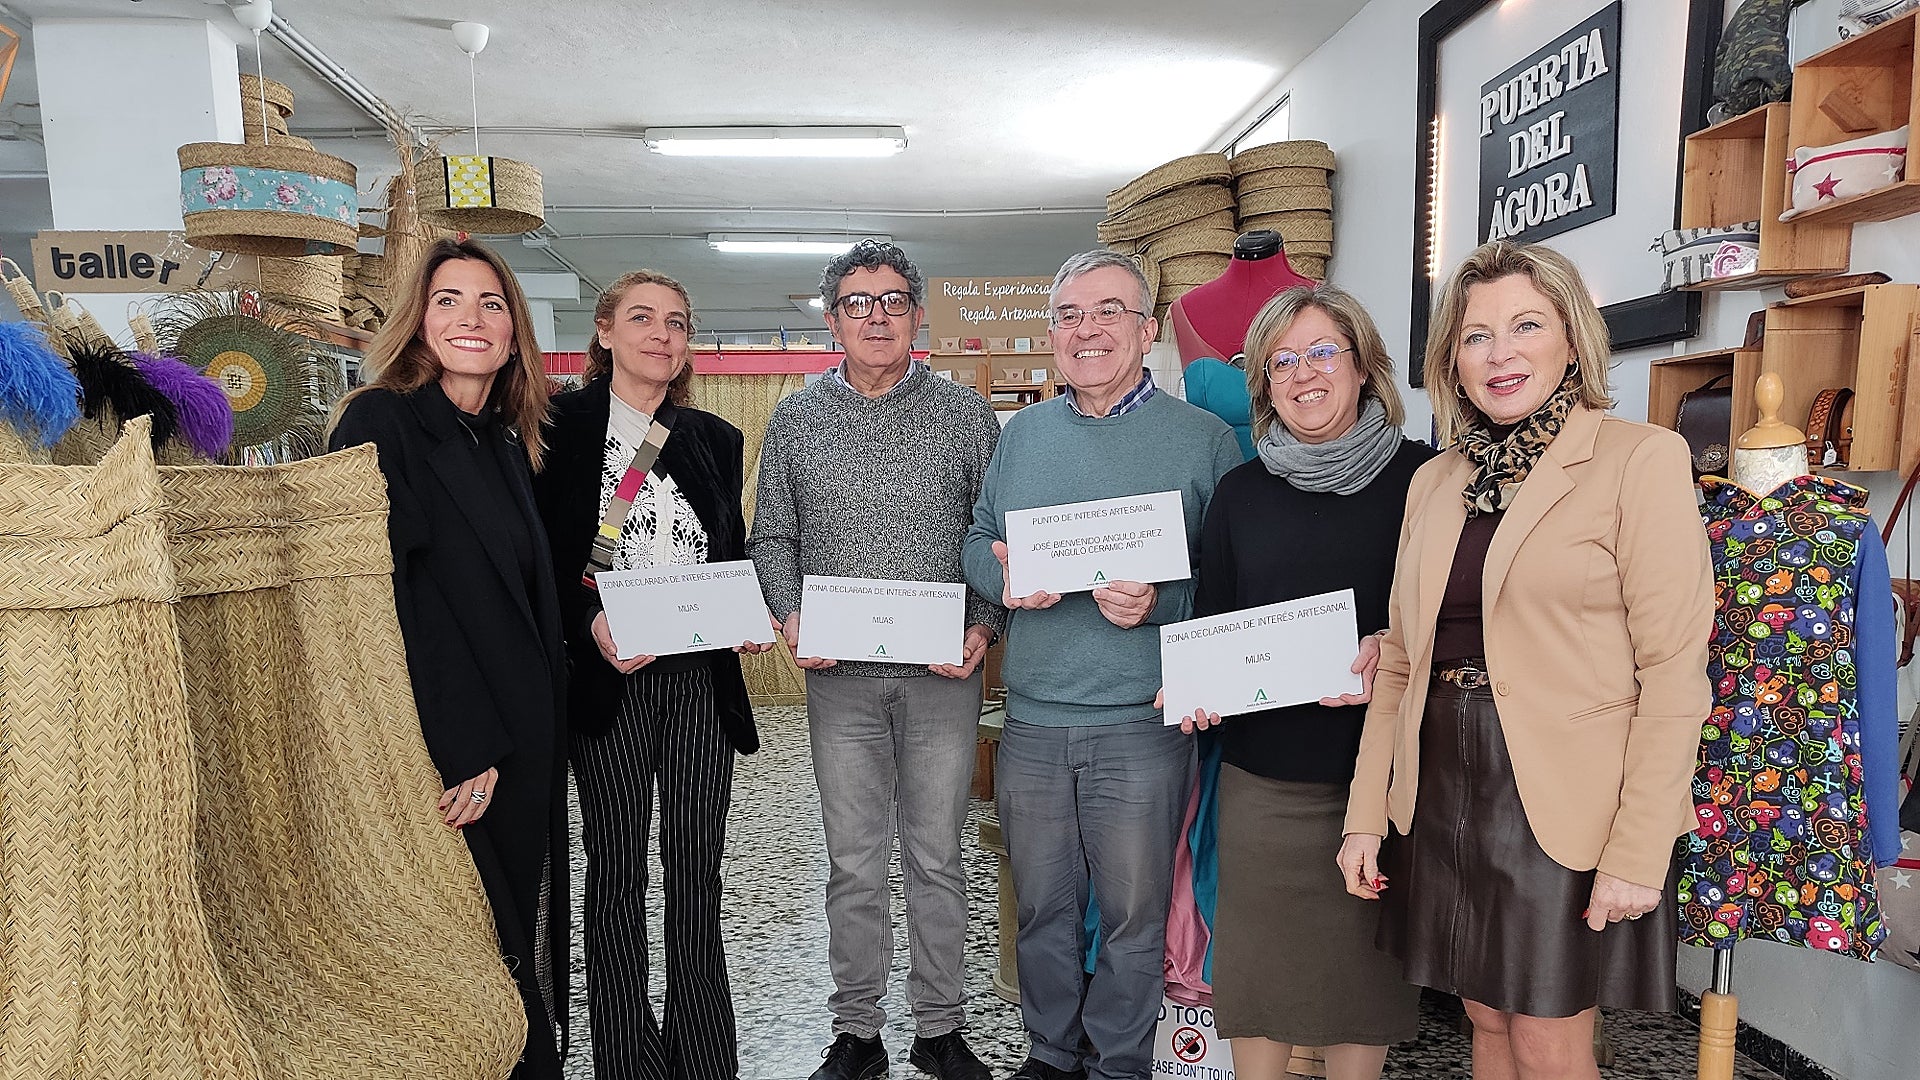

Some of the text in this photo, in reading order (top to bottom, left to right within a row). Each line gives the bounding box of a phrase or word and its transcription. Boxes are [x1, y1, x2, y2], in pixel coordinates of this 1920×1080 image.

[1480, 28, 1609, 138] PUERTA
[1507, 110, 1571, 178] DEL
[1486, 163, 1592, 243] ÁGORA
[50, 244, 180, 285] taller
[943, 280, 1051, 300] Regala Experiencia
[959, 304, 1052, 325] Regala Artesanía
[1032, 503, 1155, 525] PUNTO DE INTERÉS ARTESANAL
[1031, 539, 1051, 551] JOSÉ
[1102, 531, 1136, 543] ANGULO
[1137, 528, 1162, 539] JEREZ
[1050, 540, 1144, 559] (ANGULO CERAMIC ART)
[602, 580, 624, 590] ZONA
[625, 576, 668, 588] DECLARADA
[669, 575, 681, 584] DE
[713, 568, 753, 579] ARTESANAL
[807, 584, 961, 600] ZONA DECLARADA DE INTERÉS ARTESANAL
[1166, 601, 1350, 644] ZONA DECLARADA DE INTERÉS ARTESANAL
[1245, 652, 1271, 665] MIJAS
[1172, 1004, 1213, 1028] TOC
[1176, 1062, 1205, 1079] DON'T
[1207, 1067, 1235, 1080] TOUC
